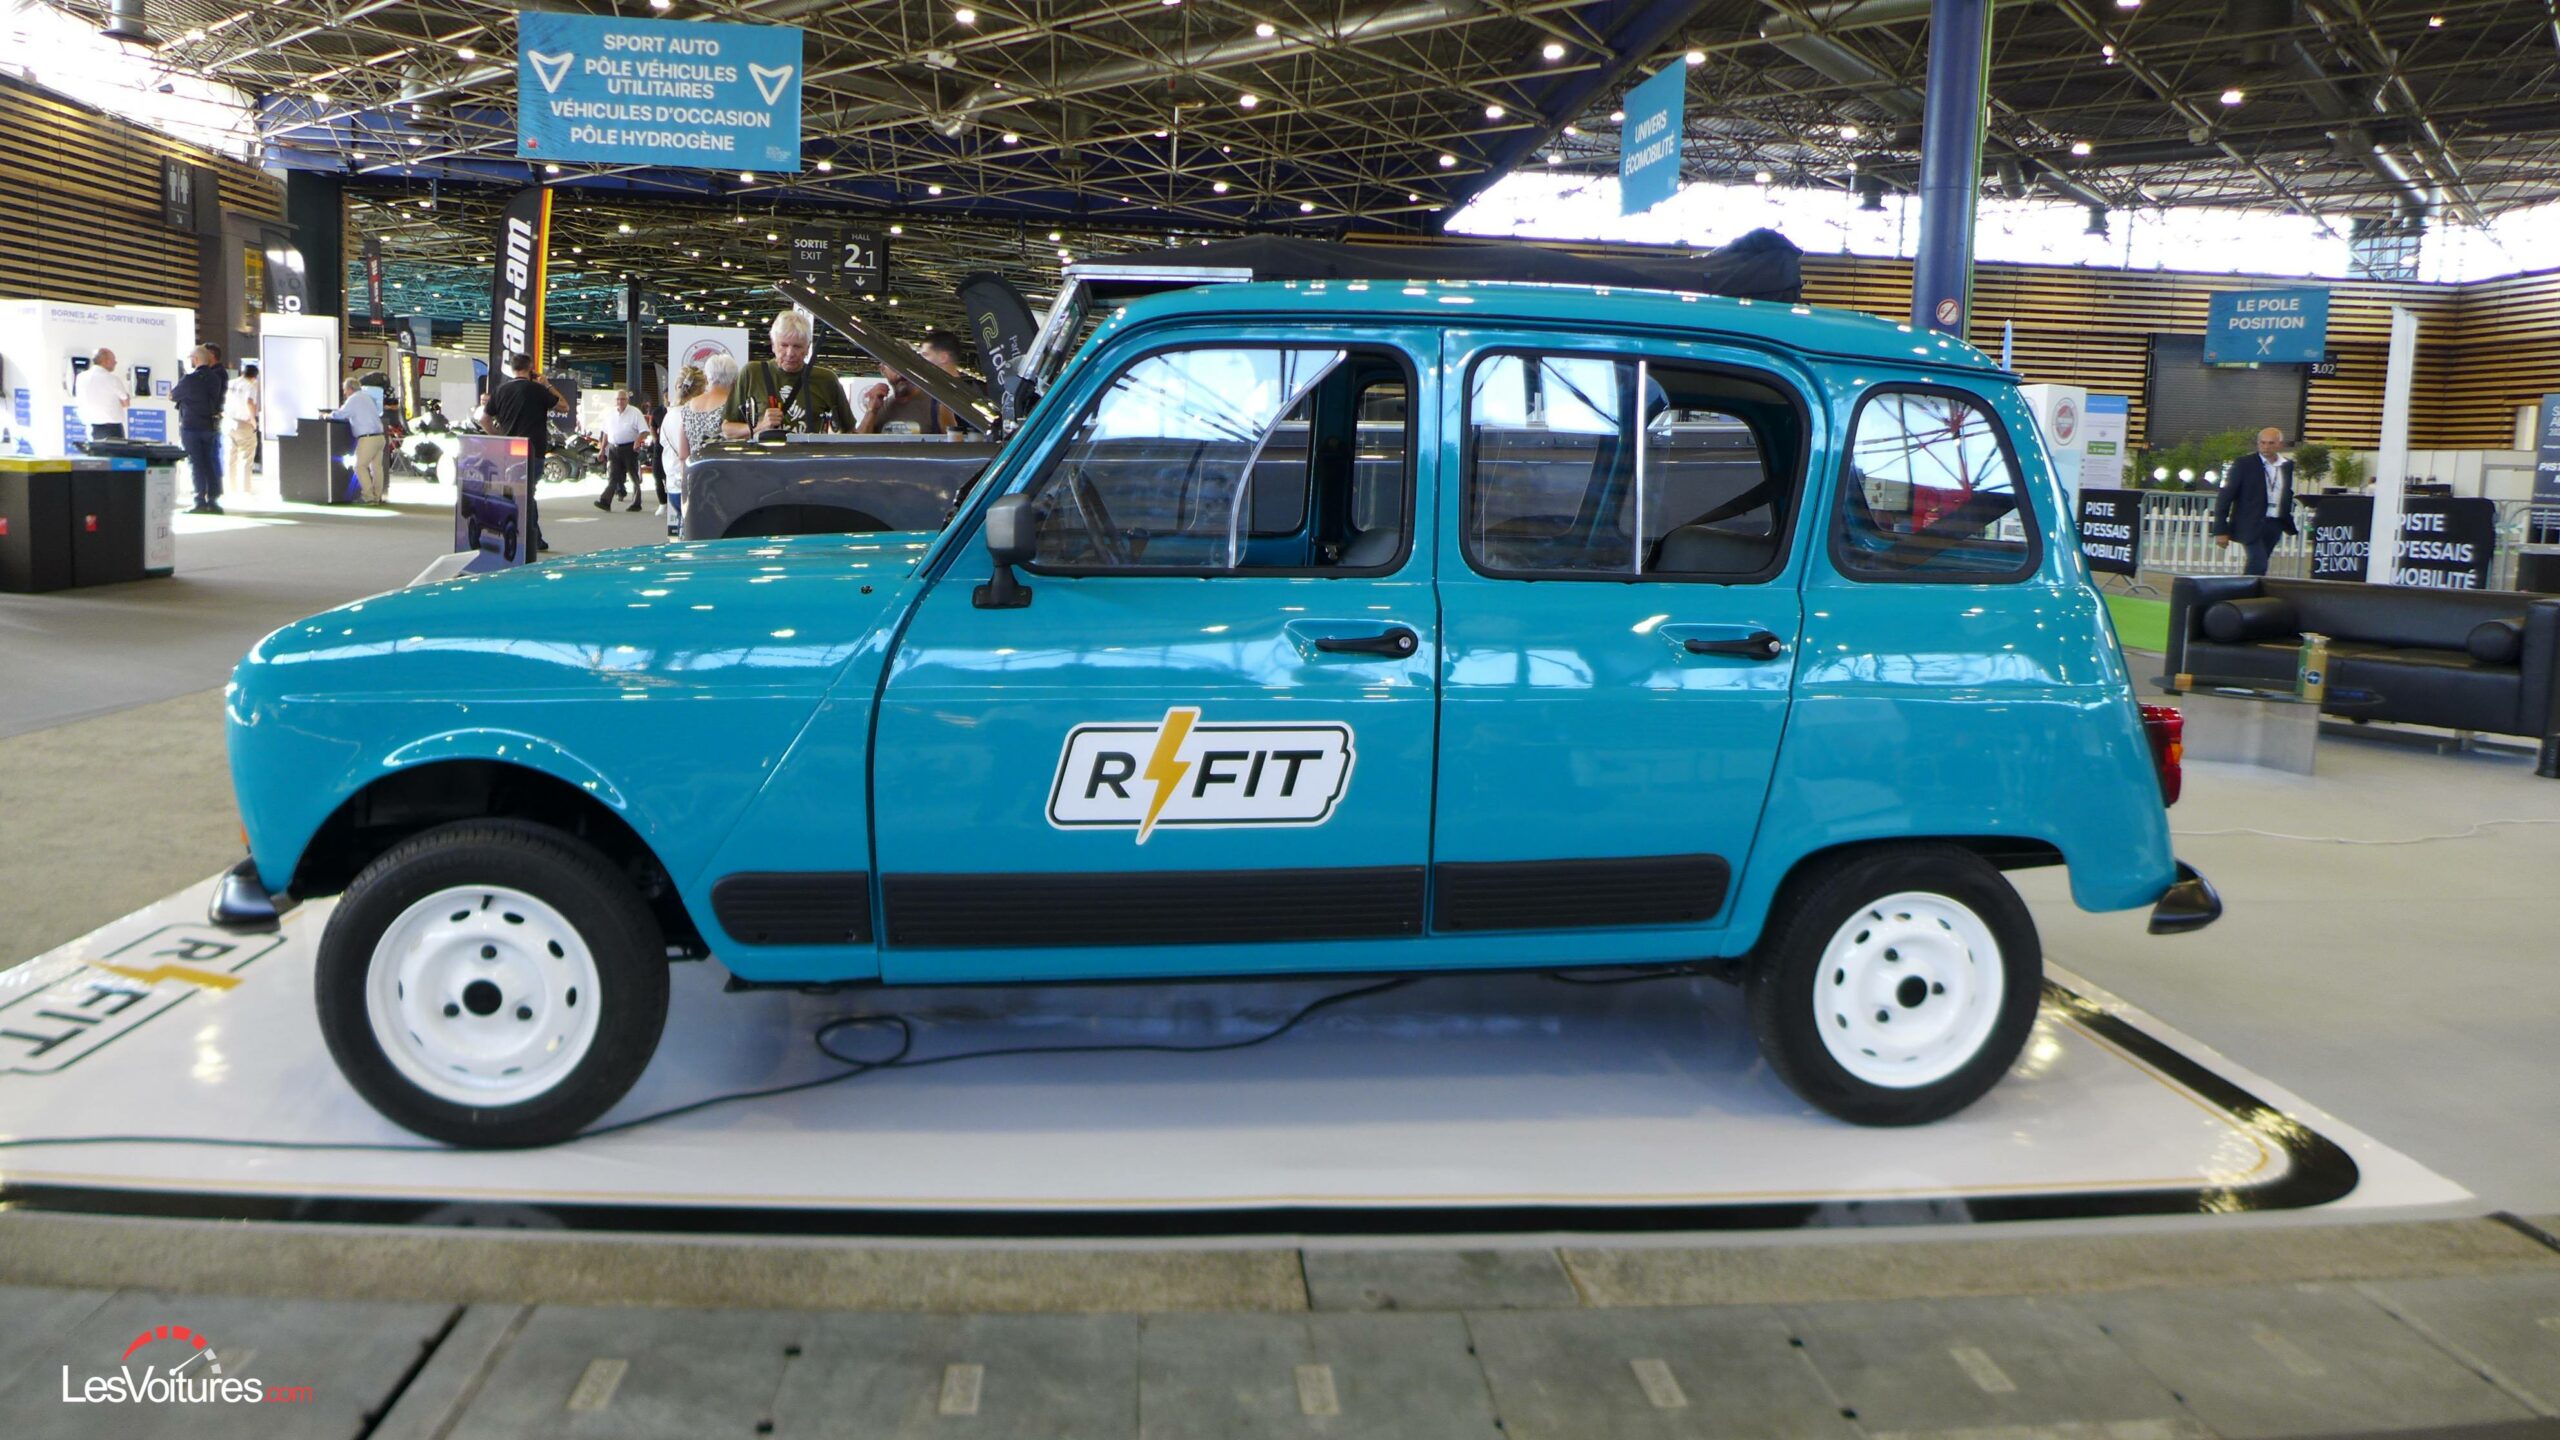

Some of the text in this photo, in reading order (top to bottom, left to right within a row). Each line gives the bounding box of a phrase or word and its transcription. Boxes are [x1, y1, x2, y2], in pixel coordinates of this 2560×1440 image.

[603, 34, 720, 56] SPORT AUTO
[585, 56, 738, 82] PÔLE VÉHICULES
[607, 78, 715, 100] UTILITAIRES
[550, 97, 771, 128] VÉHICULES D'OCCASION
[1634, 109, 1667, 144] UNIVERS
[570, 124, 735, 151] PÔLE HYDROGÈNE
[1625, 130, 1675, 177] ÉCOMOBILITÉ
[794, 239, 828, 250] SORTIE
[852, 233, 871, 241] HALL
[800, 250, 822, 261] EXIT
[844, 243, 877, 269] 2.1
[2237, 298, 2300, 312] LE POLE
[106, 315, 134, 324] SORTIE
[137, 317, 166, 327] UNIQUE
[2228, 316, 2305, 330] POSITION
[2311, 363, 2335, 375] 3.02
[2085, 501, 2115, 517] PISTE
[2083, 522, 2131, 540] D'ESSAIS
[2316, 526, 2352, 541] SALON
[2082, 542, 2132, 563] MOBILITÉ
[2330, 557, 2358, 572] LYON
